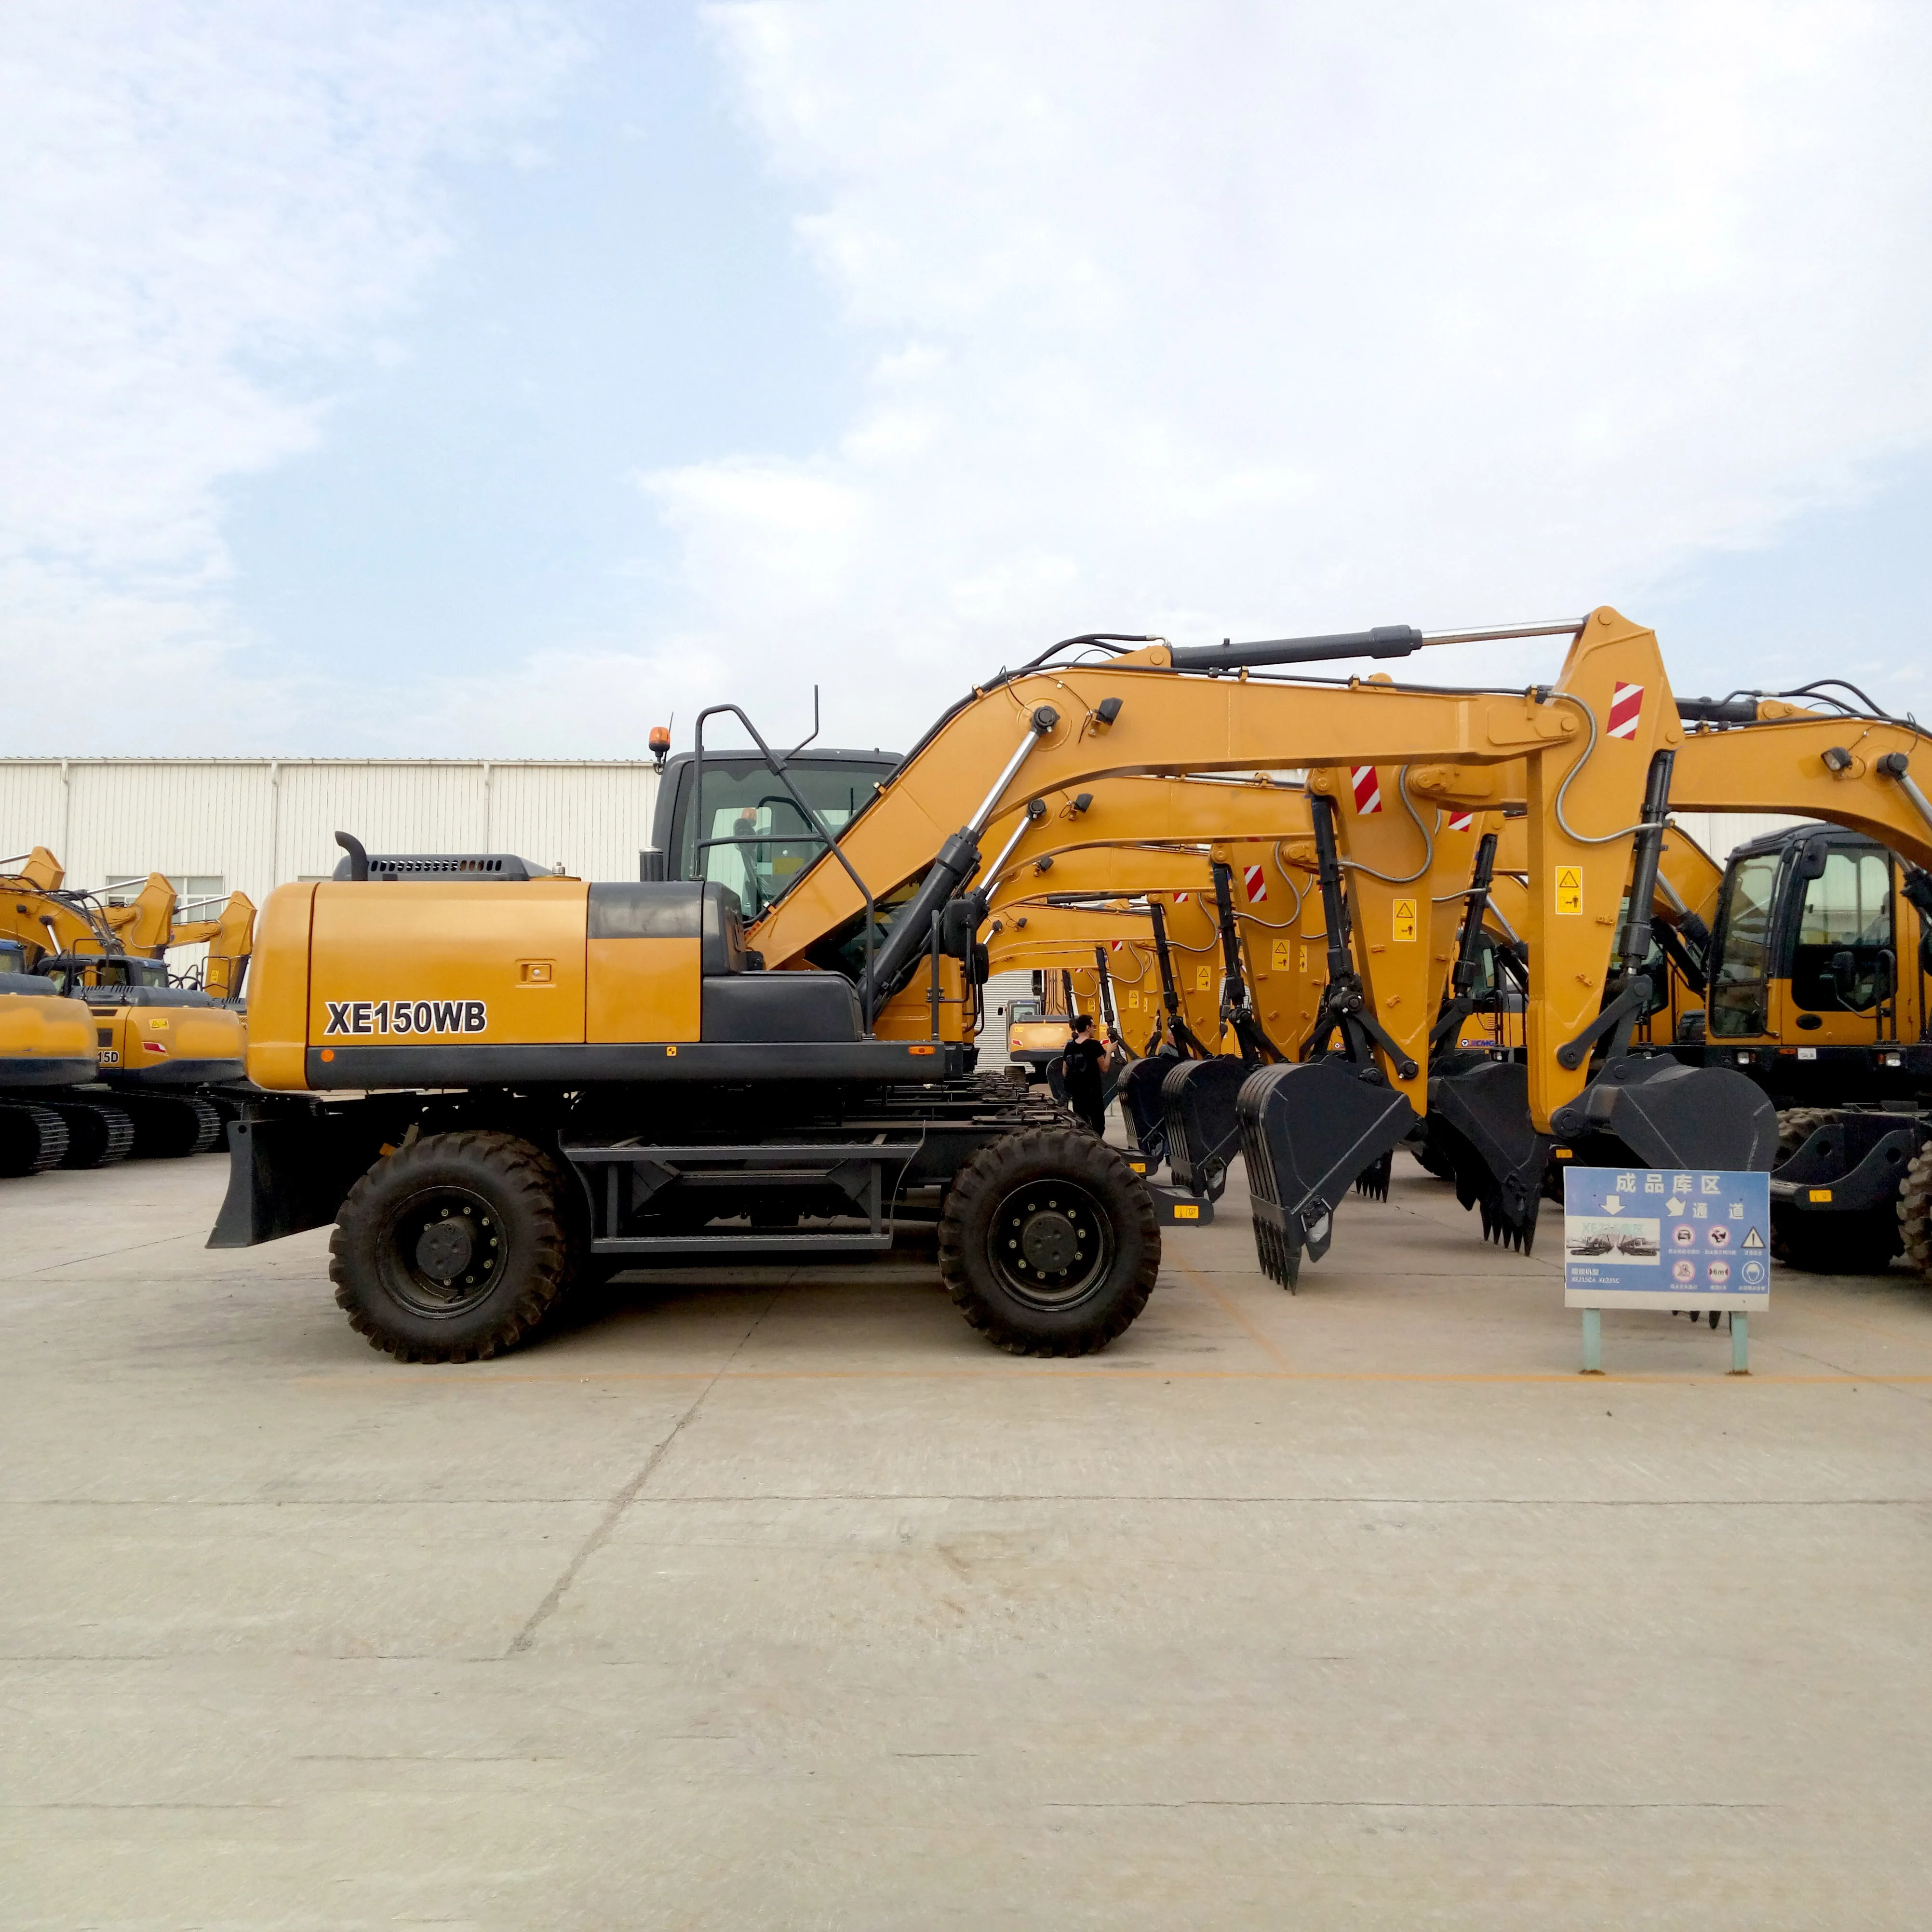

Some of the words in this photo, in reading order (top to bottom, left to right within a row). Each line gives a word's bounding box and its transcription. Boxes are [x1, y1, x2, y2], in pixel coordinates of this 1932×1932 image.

[323, 1000, 487, 1035] XE150WB
[1616, 1172, 1721, 1194] 成品库区
[1693, 1202, 1744, 1219] 通道
